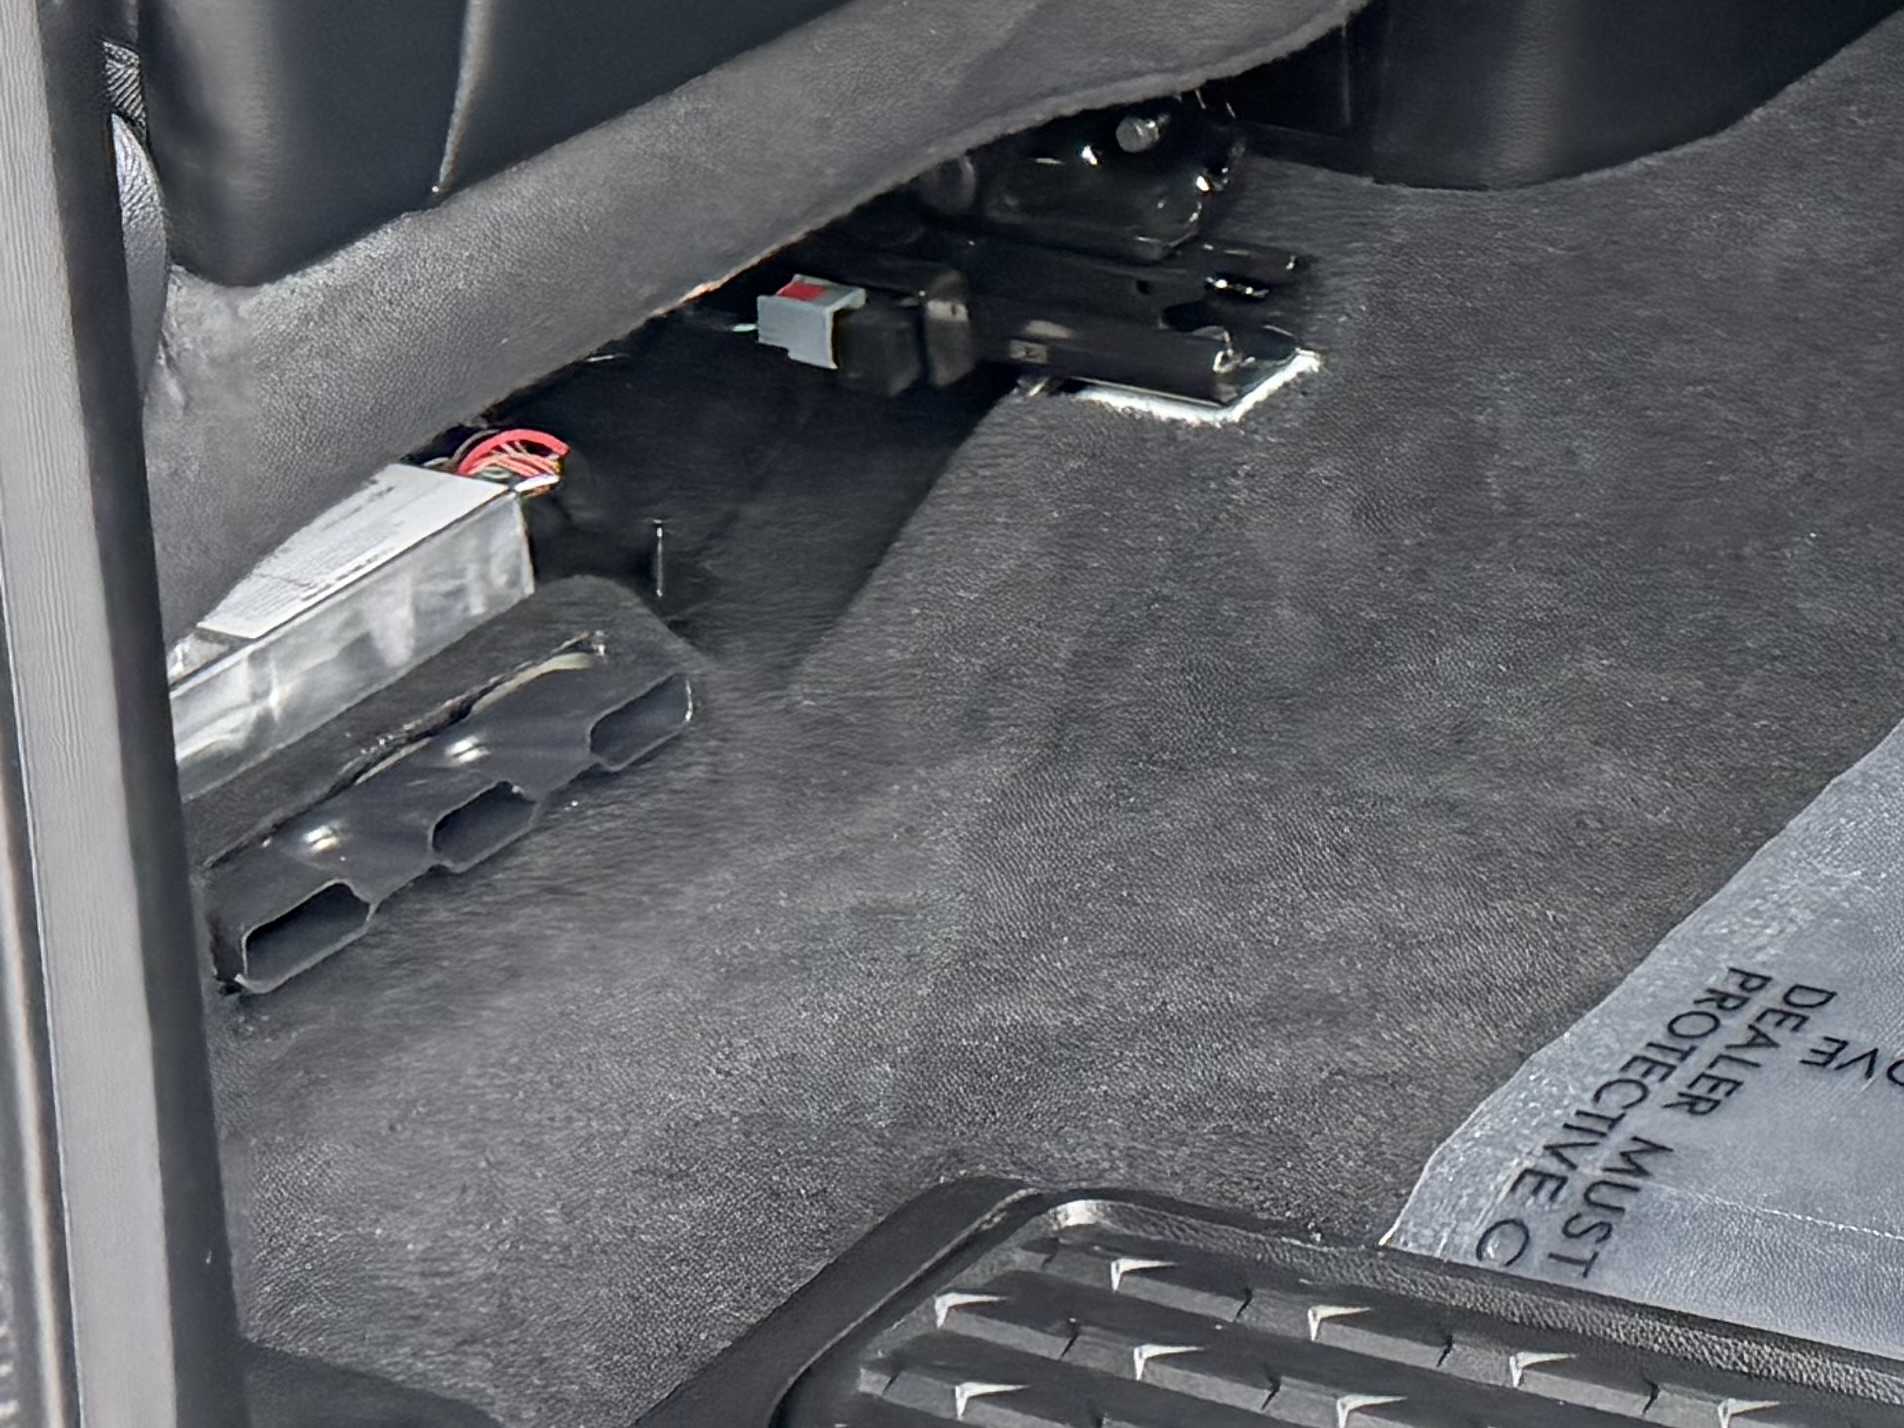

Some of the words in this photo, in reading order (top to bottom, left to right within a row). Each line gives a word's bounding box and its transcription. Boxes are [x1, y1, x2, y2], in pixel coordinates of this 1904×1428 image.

[1508, 966, 1773, 1205] PROTECTIVE
[1662, 983, 1839, 1117] DEALER
[1548, 1135, 1674, 1279] MUST
